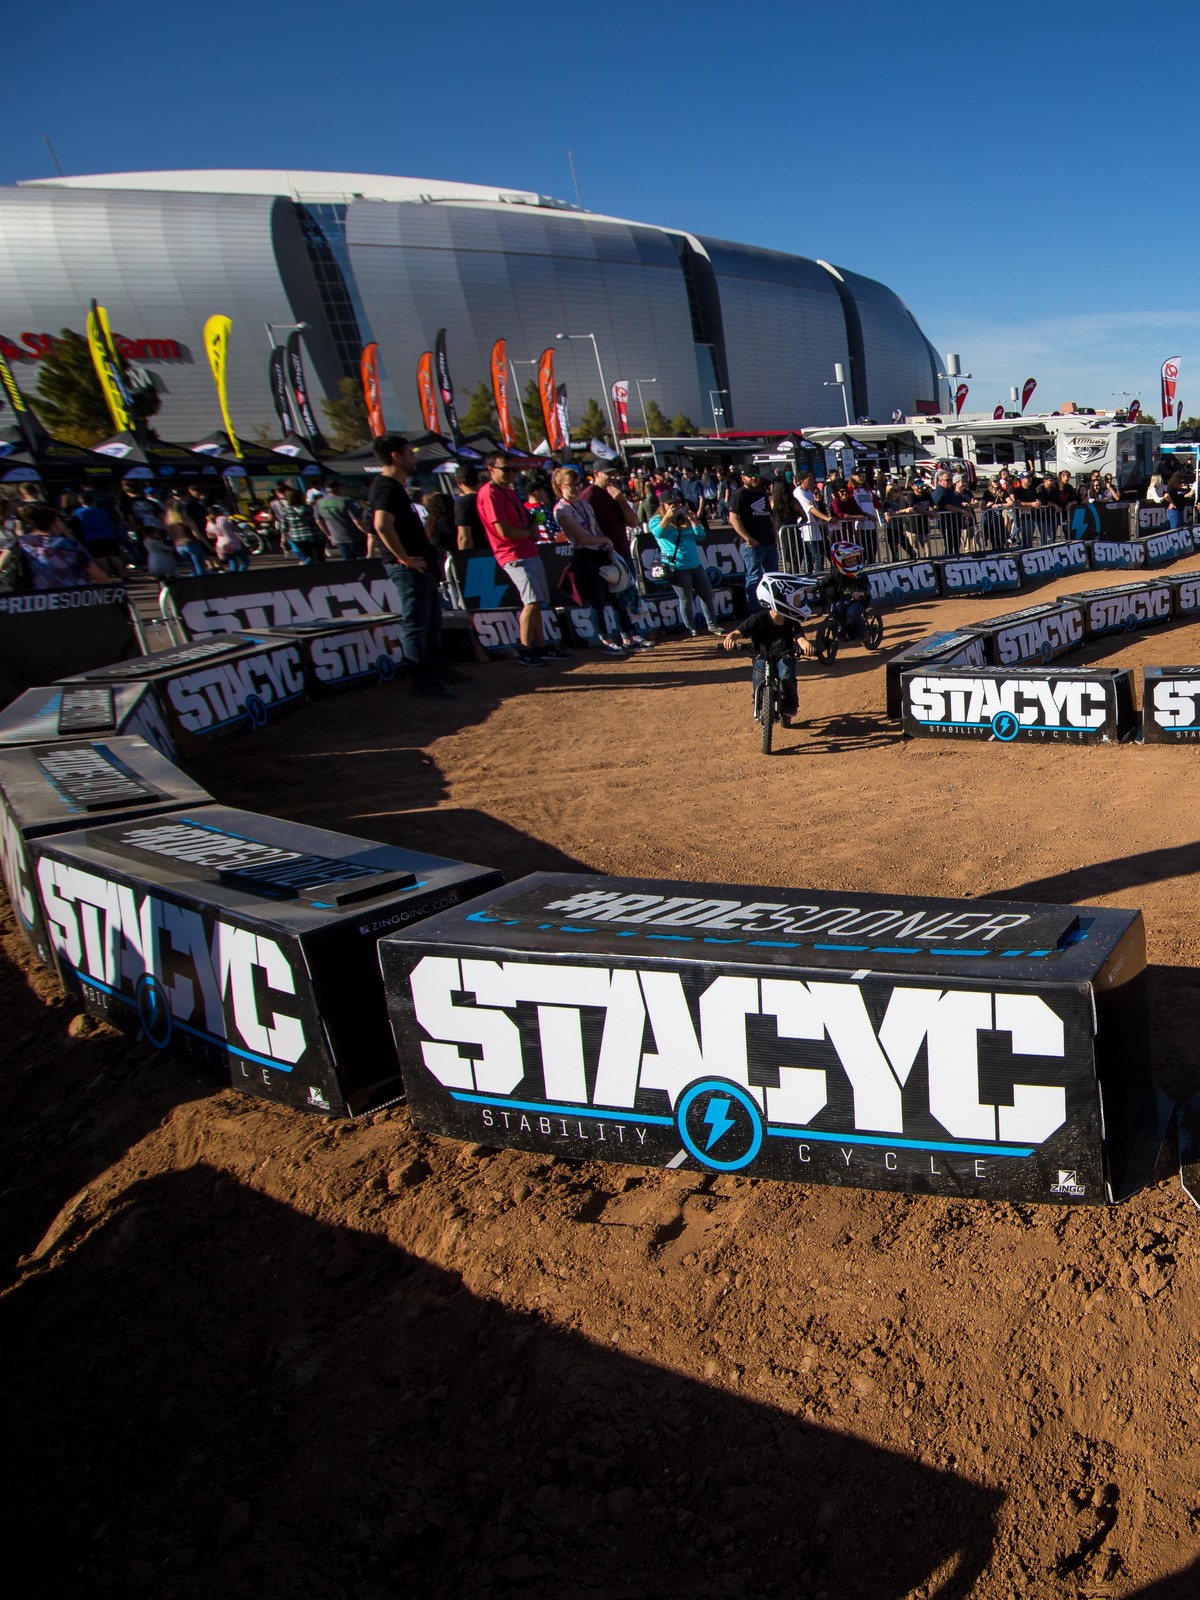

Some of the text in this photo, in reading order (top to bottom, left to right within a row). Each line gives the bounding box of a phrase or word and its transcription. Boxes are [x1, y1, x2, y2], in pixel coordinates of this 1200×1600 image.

[113, 333, 182, 358] arm
[1139, 508, 1192, 528] STAC
[1021, 543, 1087, 574] STACYC
[1094, 543, 1145, 562] STACYC
[1147, 529, 1192, 558] STACYC
[869, 563, 935, 599] TACYC
[944, 558, 1018, 587] STACYC
[181, 578, 402, 641] STACY
[1090, 589, 1170, 631] STACYC
[997, 611, 1083, 665] STACYC
[167, 646, 304, 732] STACYC
[909, 677, 1106, 727] STACYC
[930, 725, 1084, 739] STABILITY CYCLE
[121, 825, 390, 890] #RIDESOONER
[372, 896, 459, 931] ZINGGINC.COM
[543, 890, 1031, 940] #RIDESOONER
[37, 856, 306, 1064] STACYC
[410, 956, 1067, 1143] STACYC
[482, 1109, 987, 1178] STABILITY CYCLE
[1050, 1184, 1085, 1195] ZINGG
